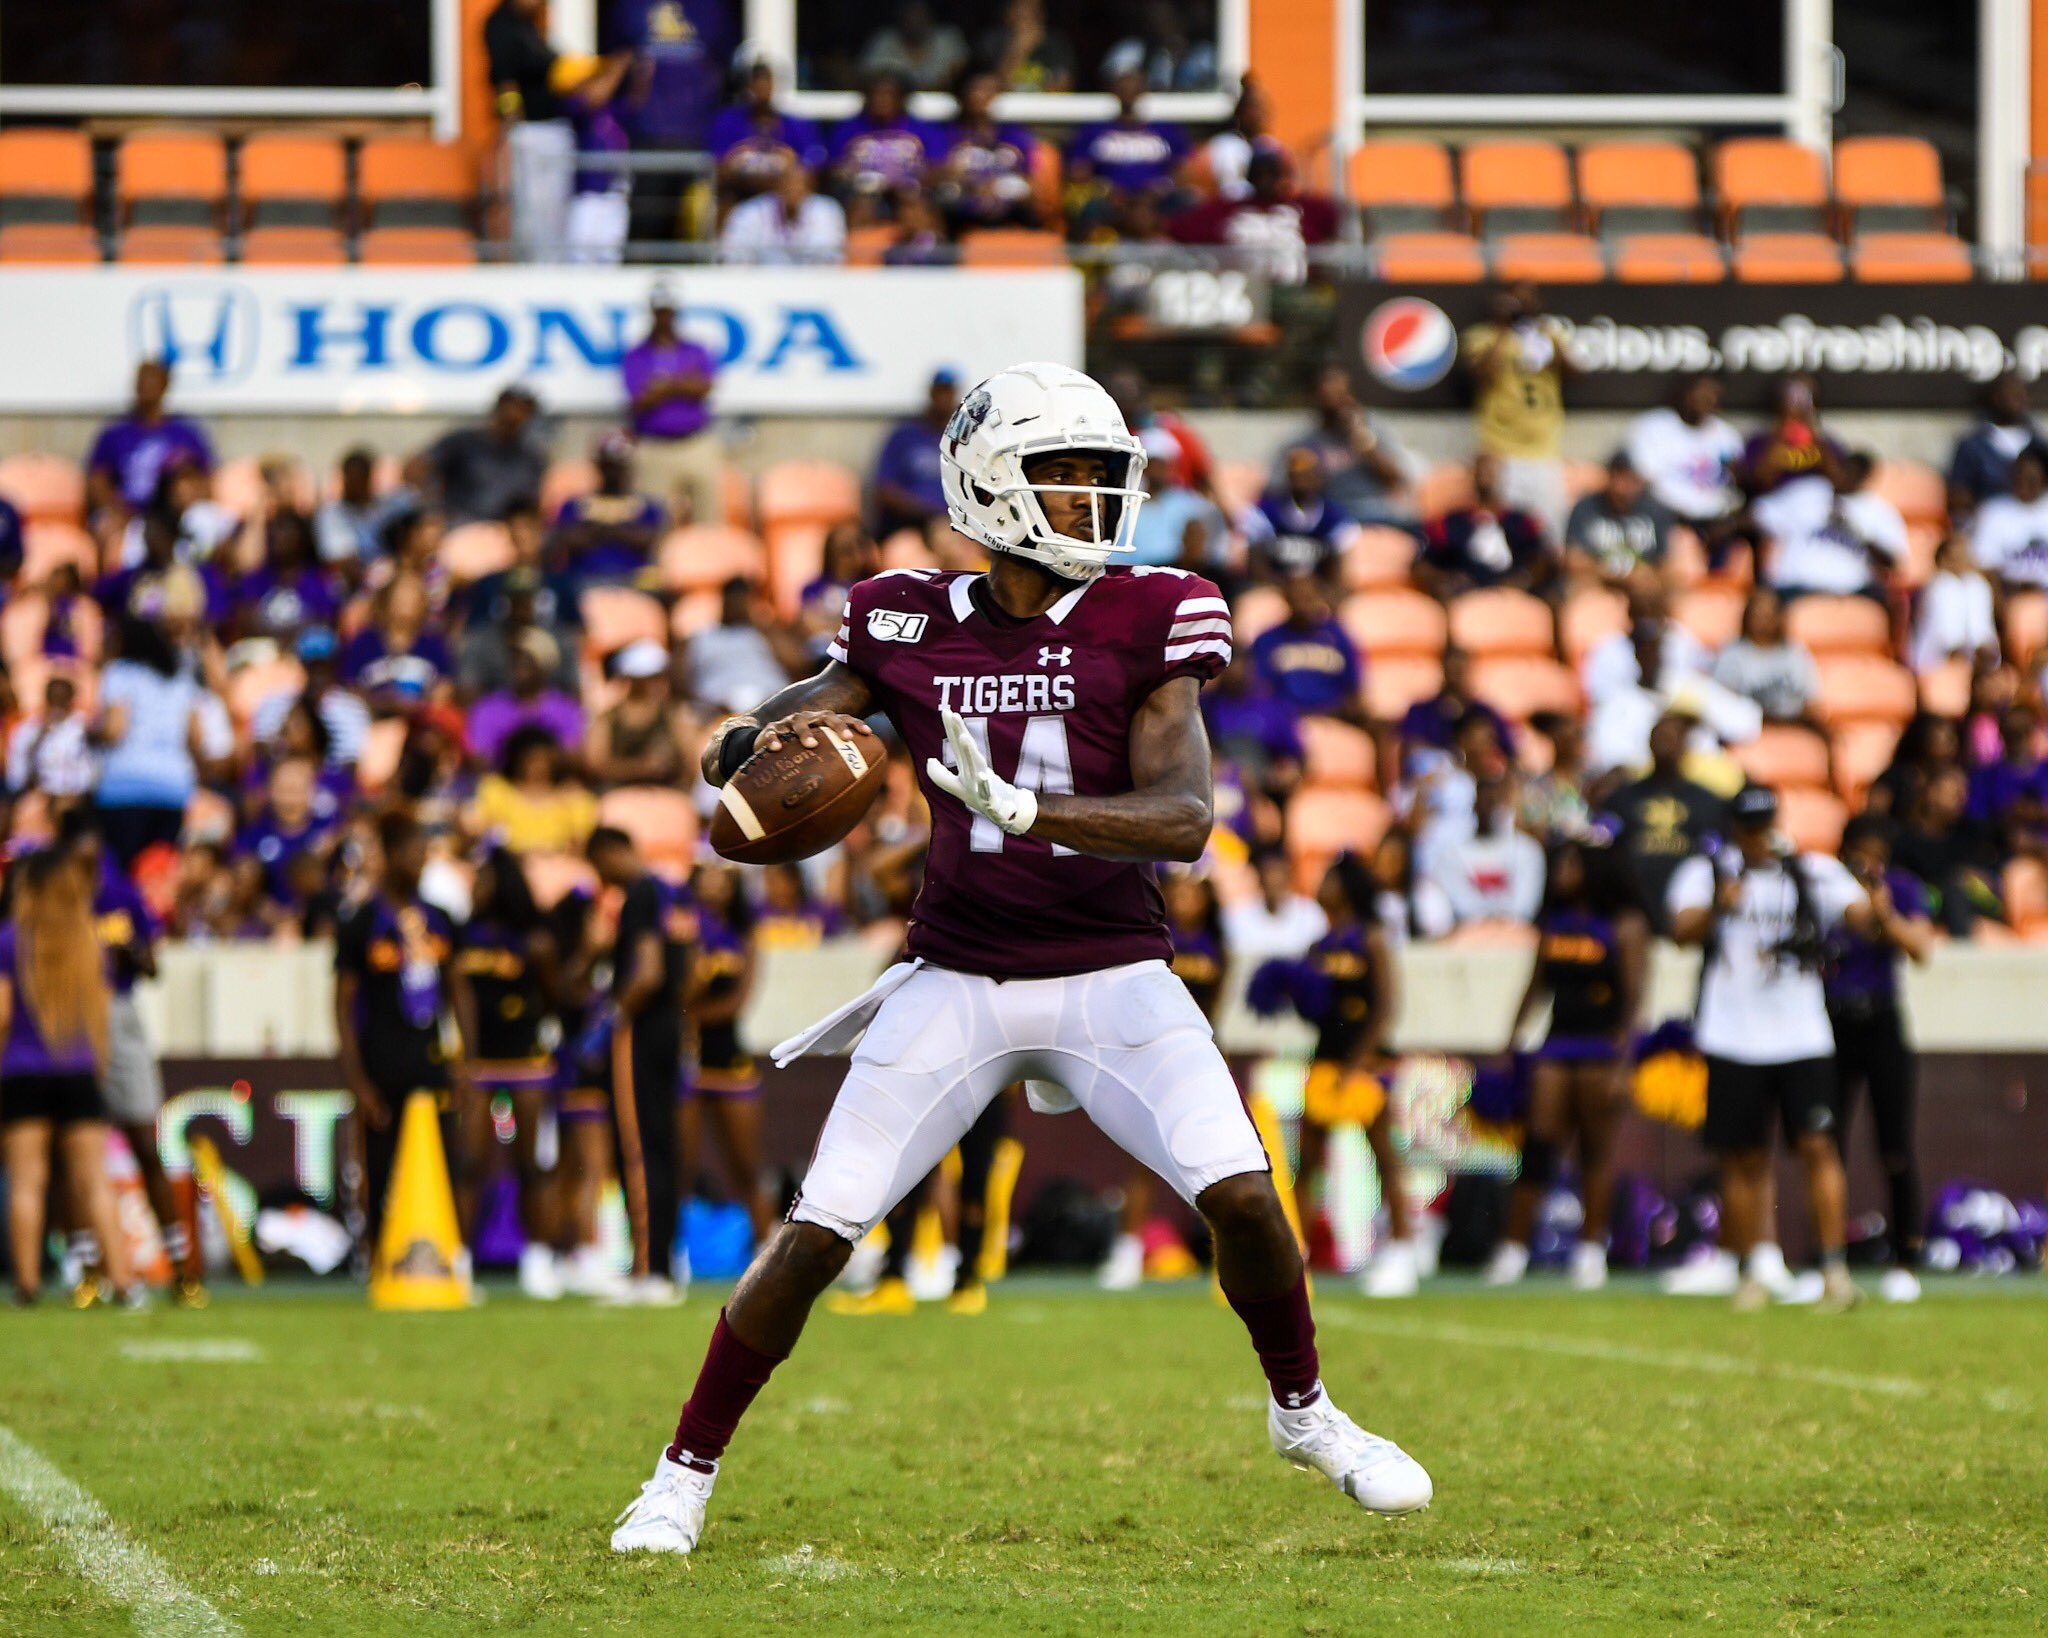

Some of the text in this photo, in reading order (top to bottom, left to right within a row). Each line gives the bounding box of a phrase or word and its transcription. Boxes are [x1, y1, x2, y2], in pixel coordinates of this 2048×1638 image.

[1721, 313, 2015, 383] refreshing.
[868, 609, 927, 641] 150
[932, 673, 1076, 714] TIGERS
